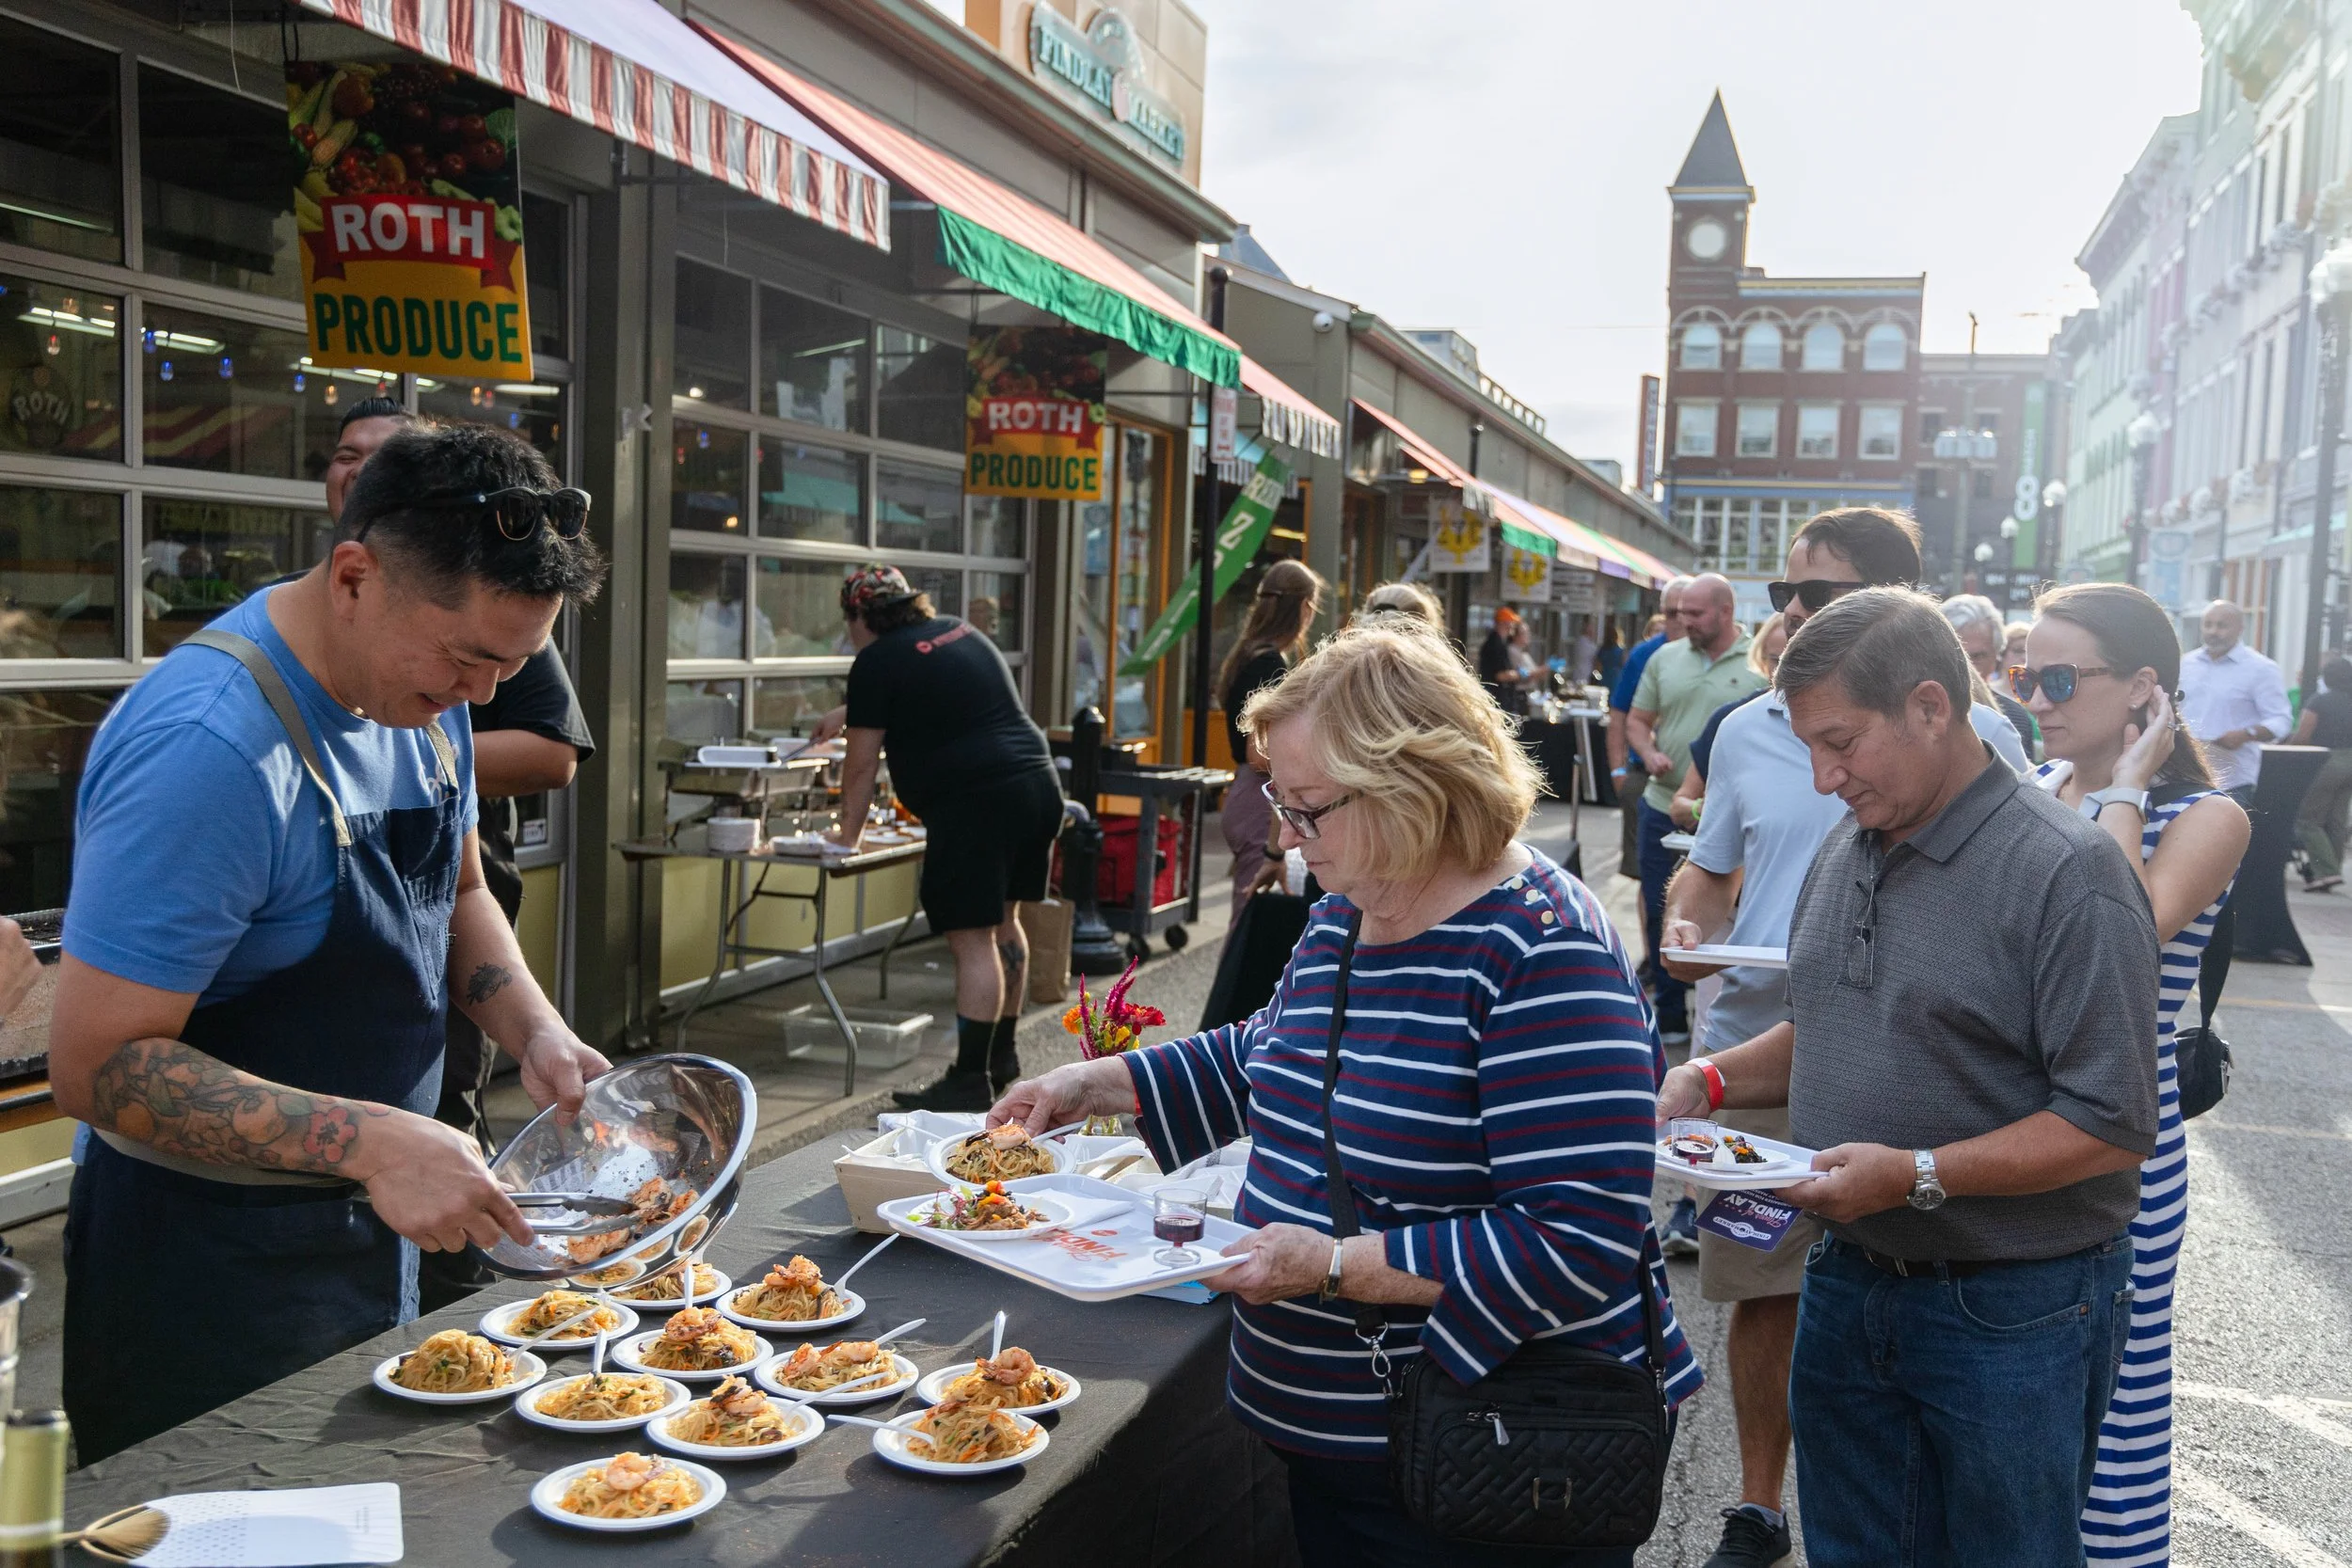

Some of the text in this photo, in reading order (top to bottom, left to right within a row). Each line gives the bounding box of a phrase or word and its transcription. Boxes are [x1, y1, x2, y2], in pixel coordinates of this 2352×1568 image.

[1040, 25, 1113, 109] FINDLAY
[331, 202, 485, 259] ROTH
[313, 293, 523, 363] PRODUCE
[12, 390, 72, 426] ROTH
[988, 401, 1083, 434] ROTH
[971, 451, 1098, 492] PRODUCE
[1714, 1216, 1740, 1230] MARKET
[1724, 1194, 1792, 1220] FINDLAY
[1745, 1228, 1770, 1240] FINDLAY
